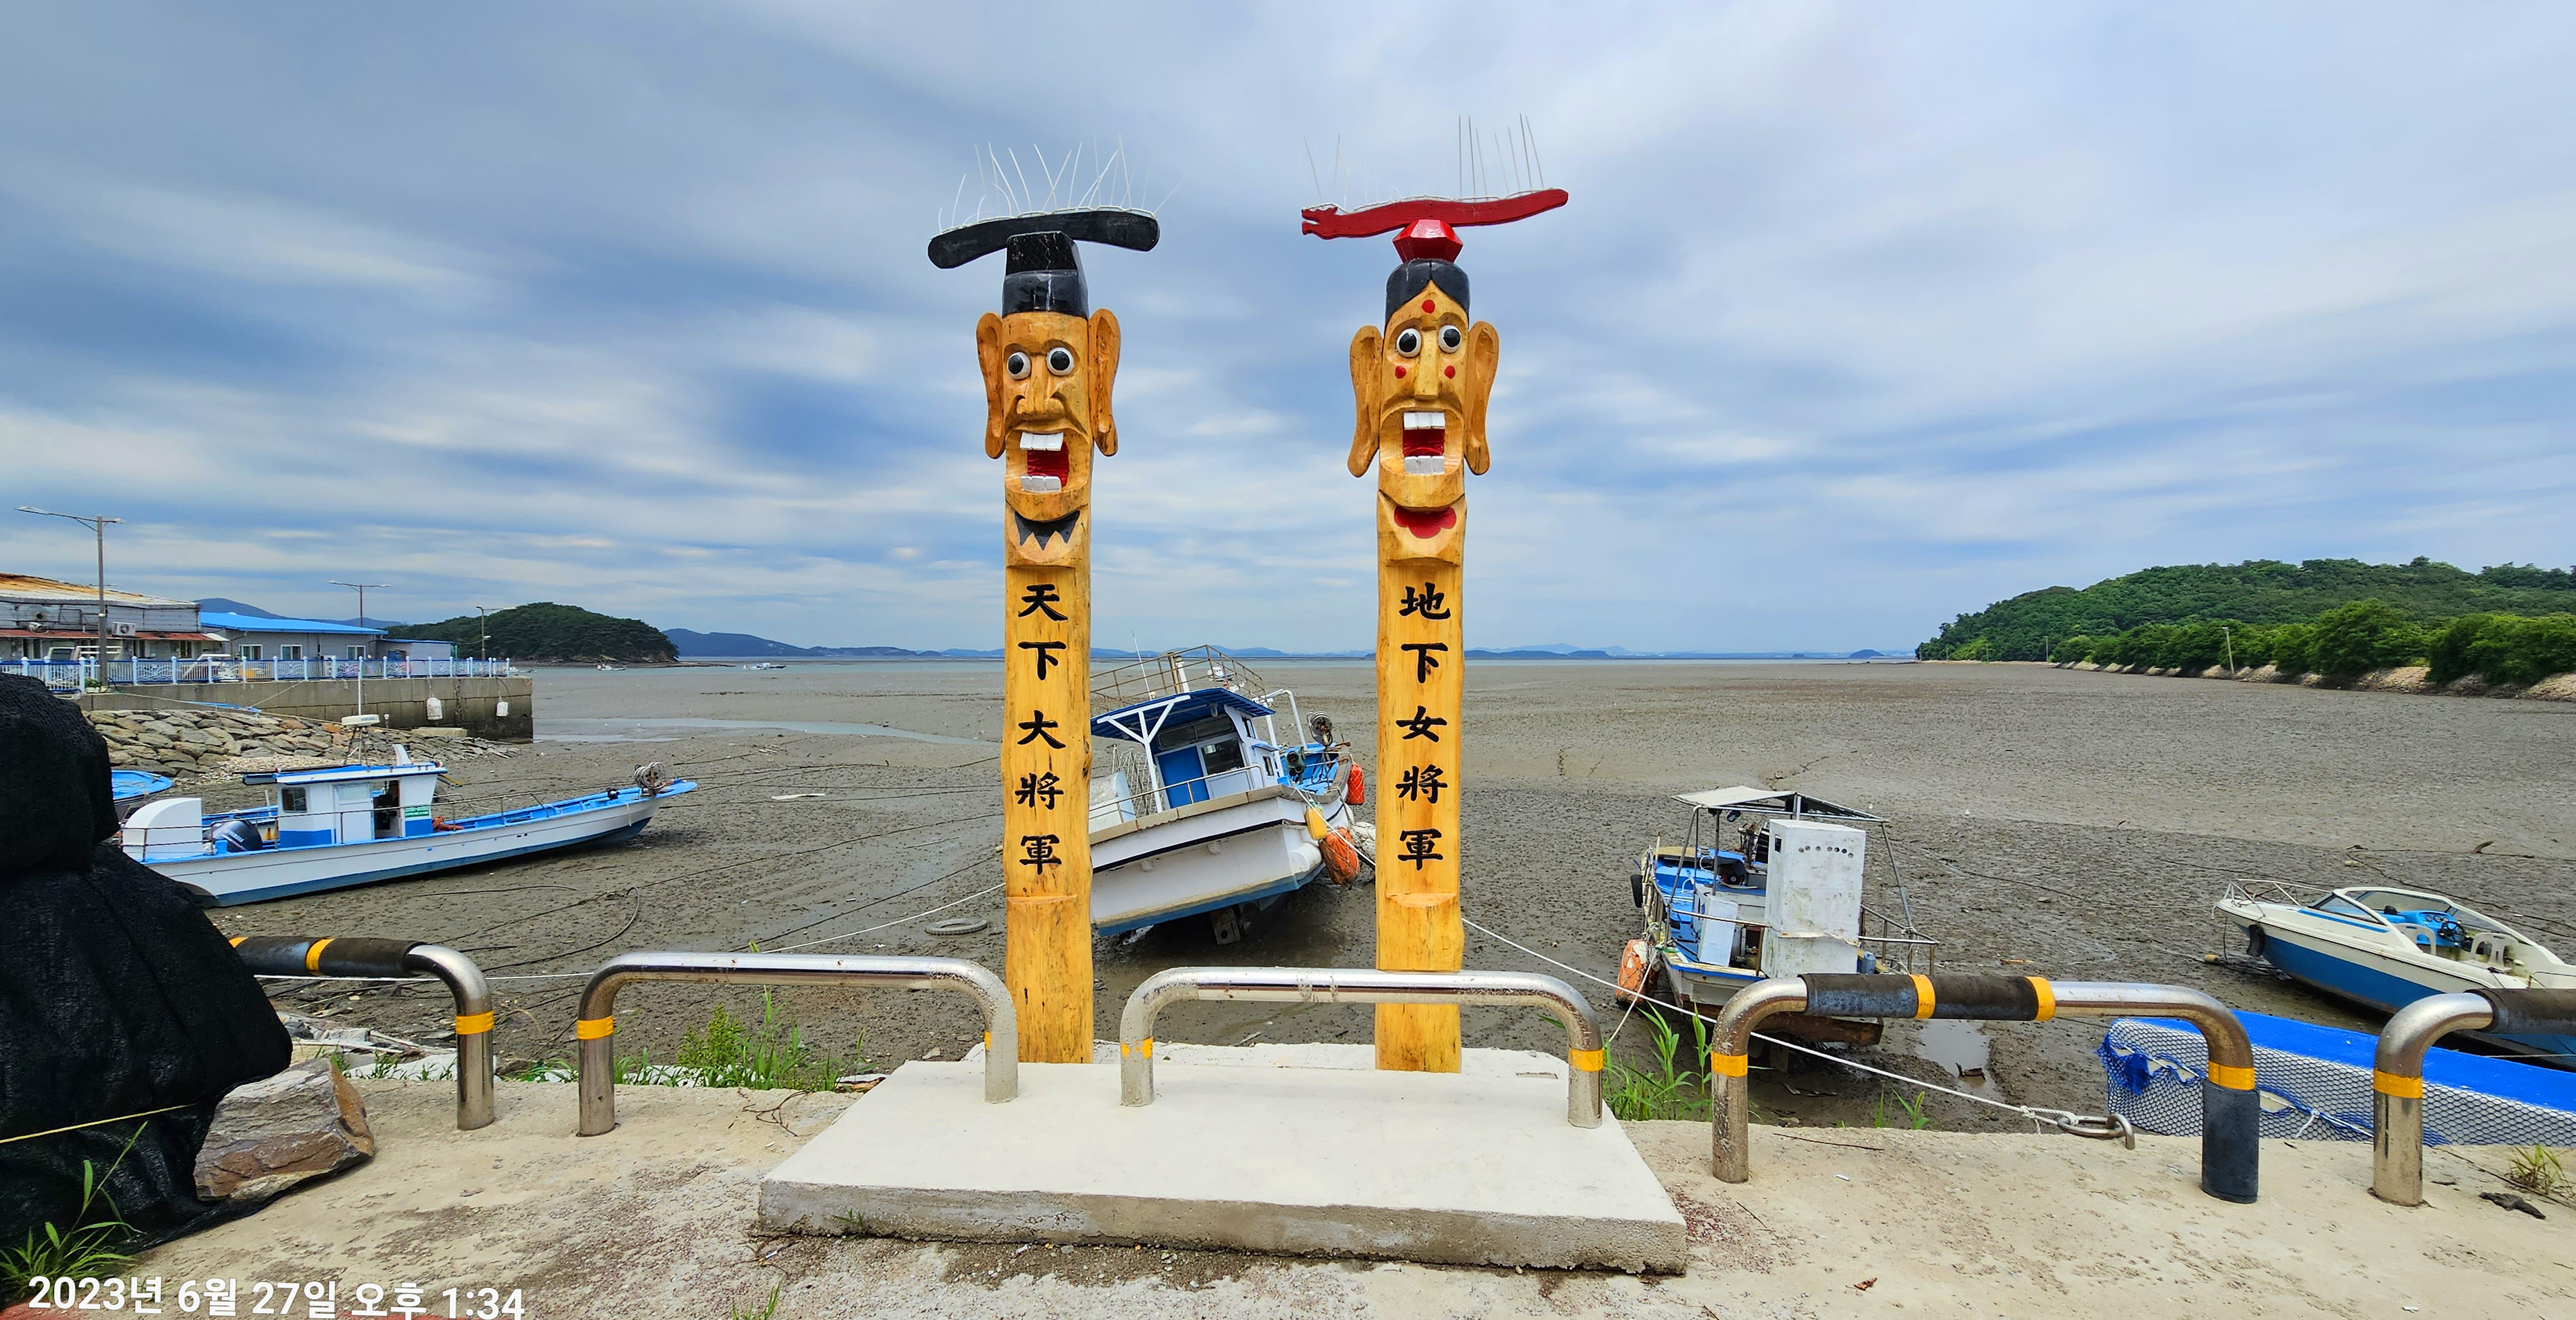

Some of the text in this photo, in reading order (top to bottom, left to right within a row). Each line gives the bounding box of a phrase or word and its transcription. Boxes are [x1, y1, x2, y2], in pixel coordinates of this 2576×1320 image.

[1015, 584, 1069, 875] 天下大將軍
[1396, 582, 1451, 871] 地下女將軍
